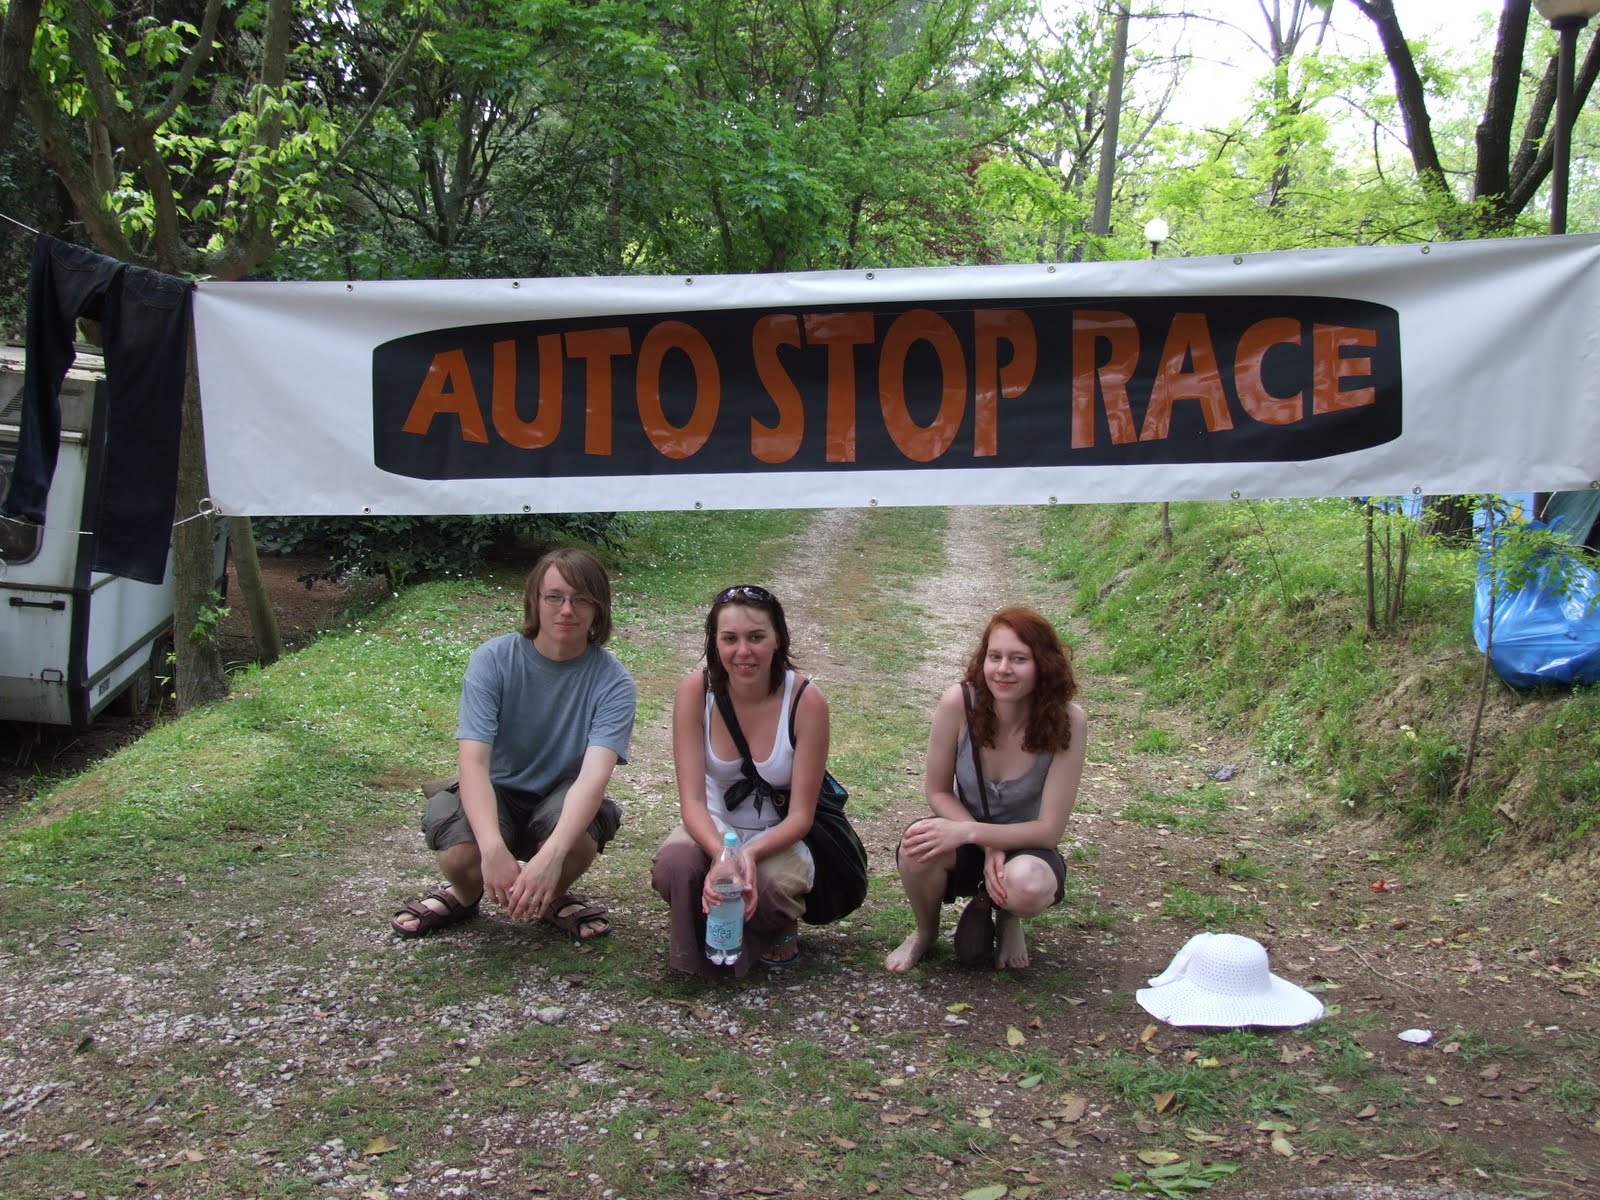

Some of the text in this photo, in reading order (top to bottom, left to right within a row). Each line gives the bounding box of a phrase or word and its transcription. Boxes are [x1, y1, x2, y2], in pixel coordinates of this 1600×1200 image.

[403, 309, 1378, 464] AUTO STOP RACE
